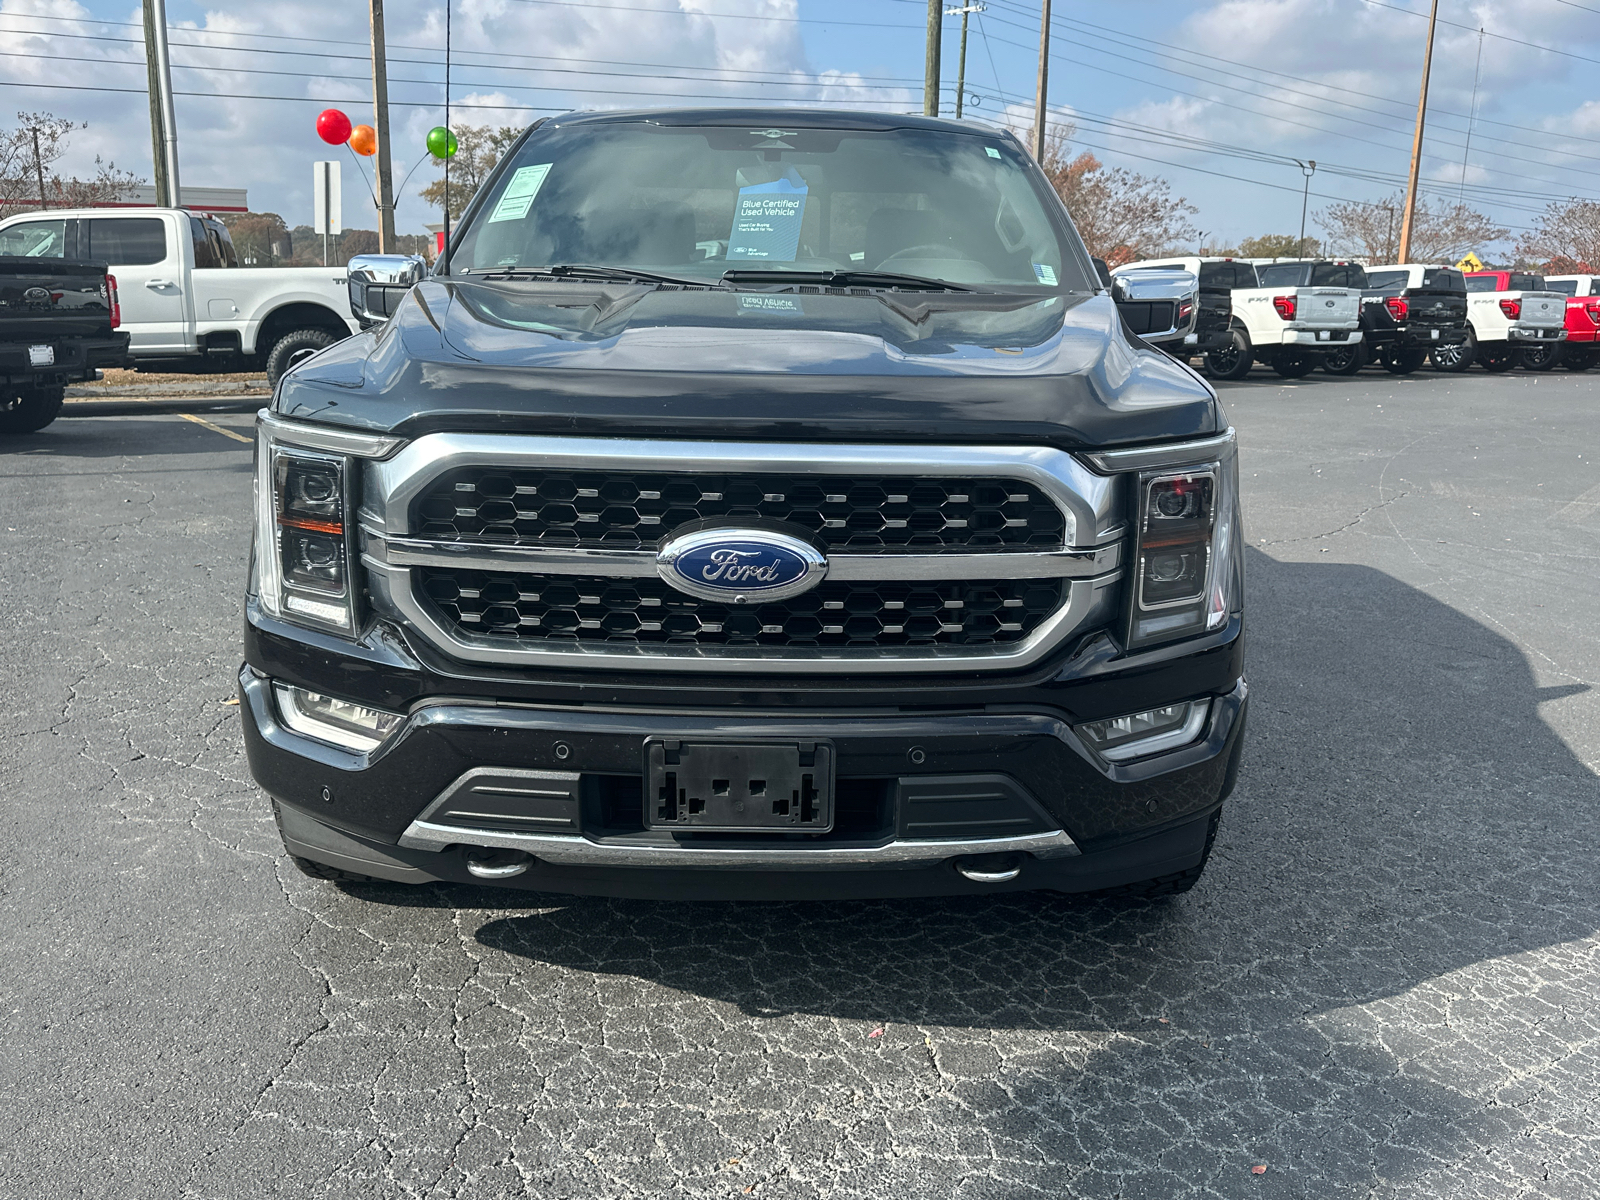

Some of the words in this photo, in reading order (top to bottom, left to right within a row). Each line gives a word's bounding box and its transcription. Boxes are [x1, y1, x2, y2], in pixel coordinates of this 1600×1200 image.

[742, 200, 761, 208] Blue
[762, 199, 799, 208] Certified
[741, 208, 763, 216] Used
[765, 208, 795, 216] Vehicle
[702, 549, 781, 582] Ford
